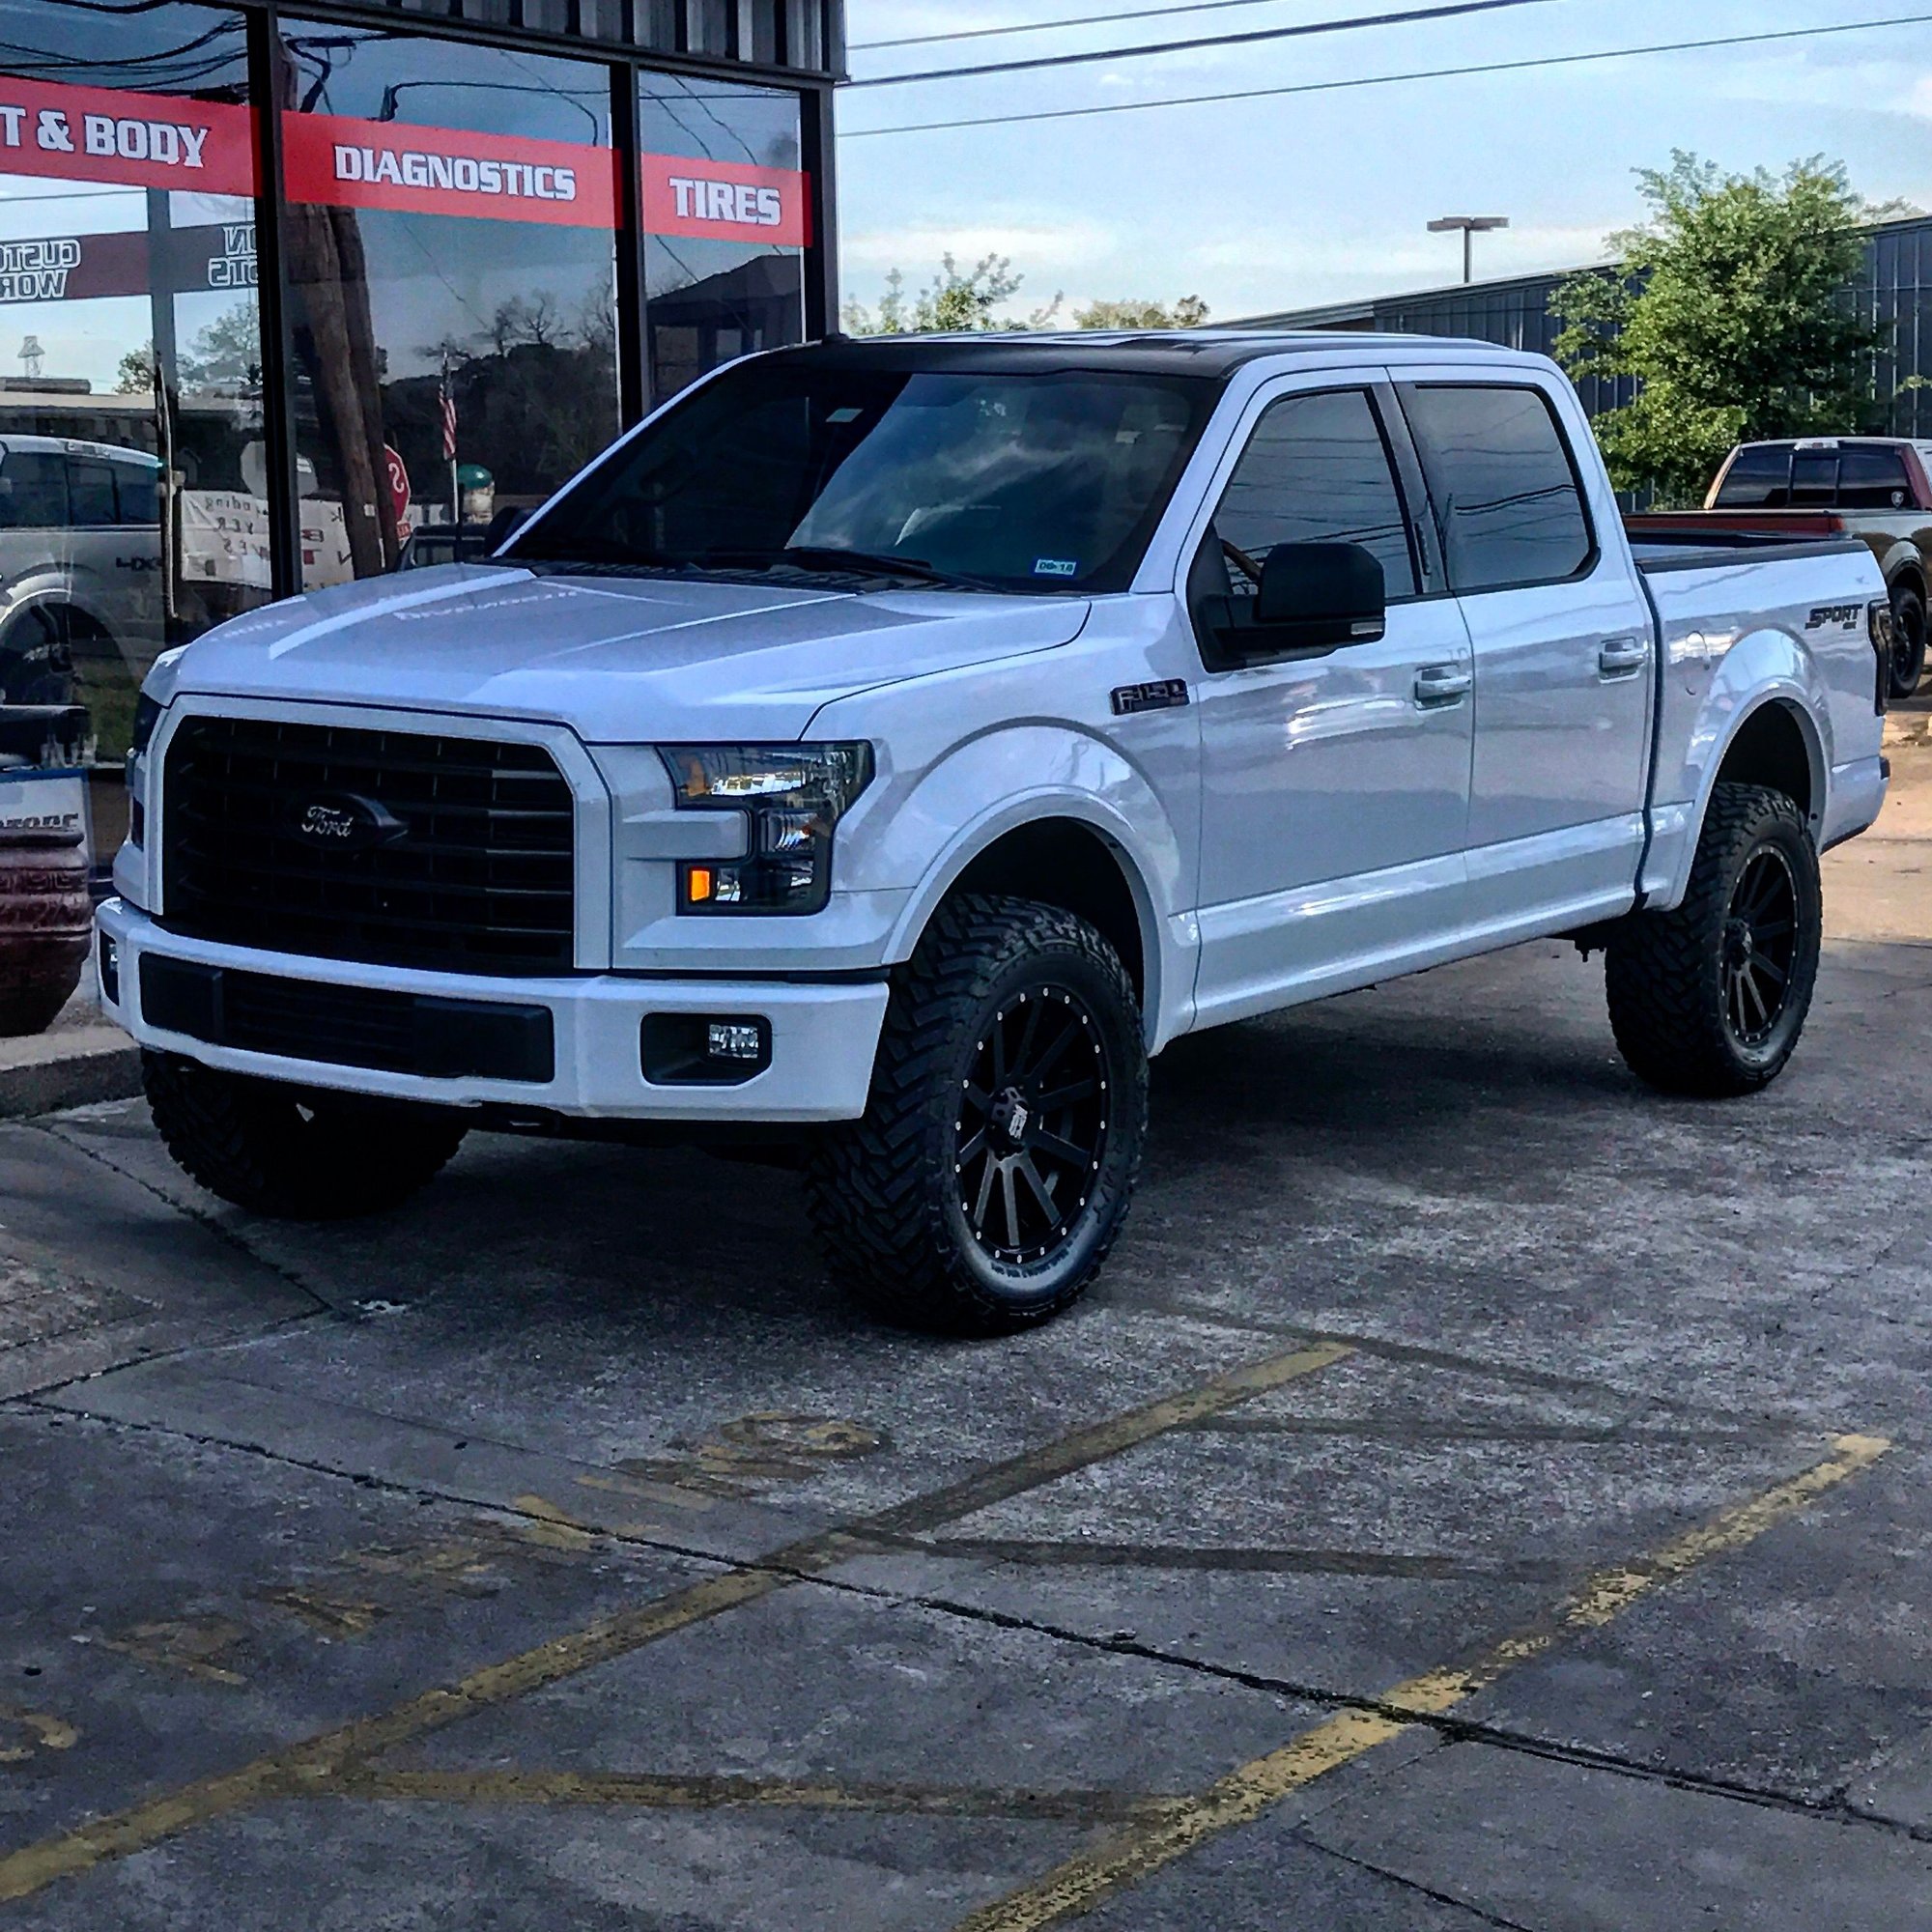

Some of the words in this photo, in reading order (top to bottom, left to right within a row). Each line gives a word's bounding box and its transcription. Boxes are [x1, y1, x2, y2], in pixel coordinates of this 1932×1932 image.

[0, 106, 27, 148] T
[36, 109, 75, 153] &
[83, 113, 209, 169] BODY
[333, 144, 577, 202] DIAGNOSTICS
[668, 176, 781, 227] TIRES
[1804, 603, 1864, 630] SPORT
[300, 806, 355, 838] Ford
